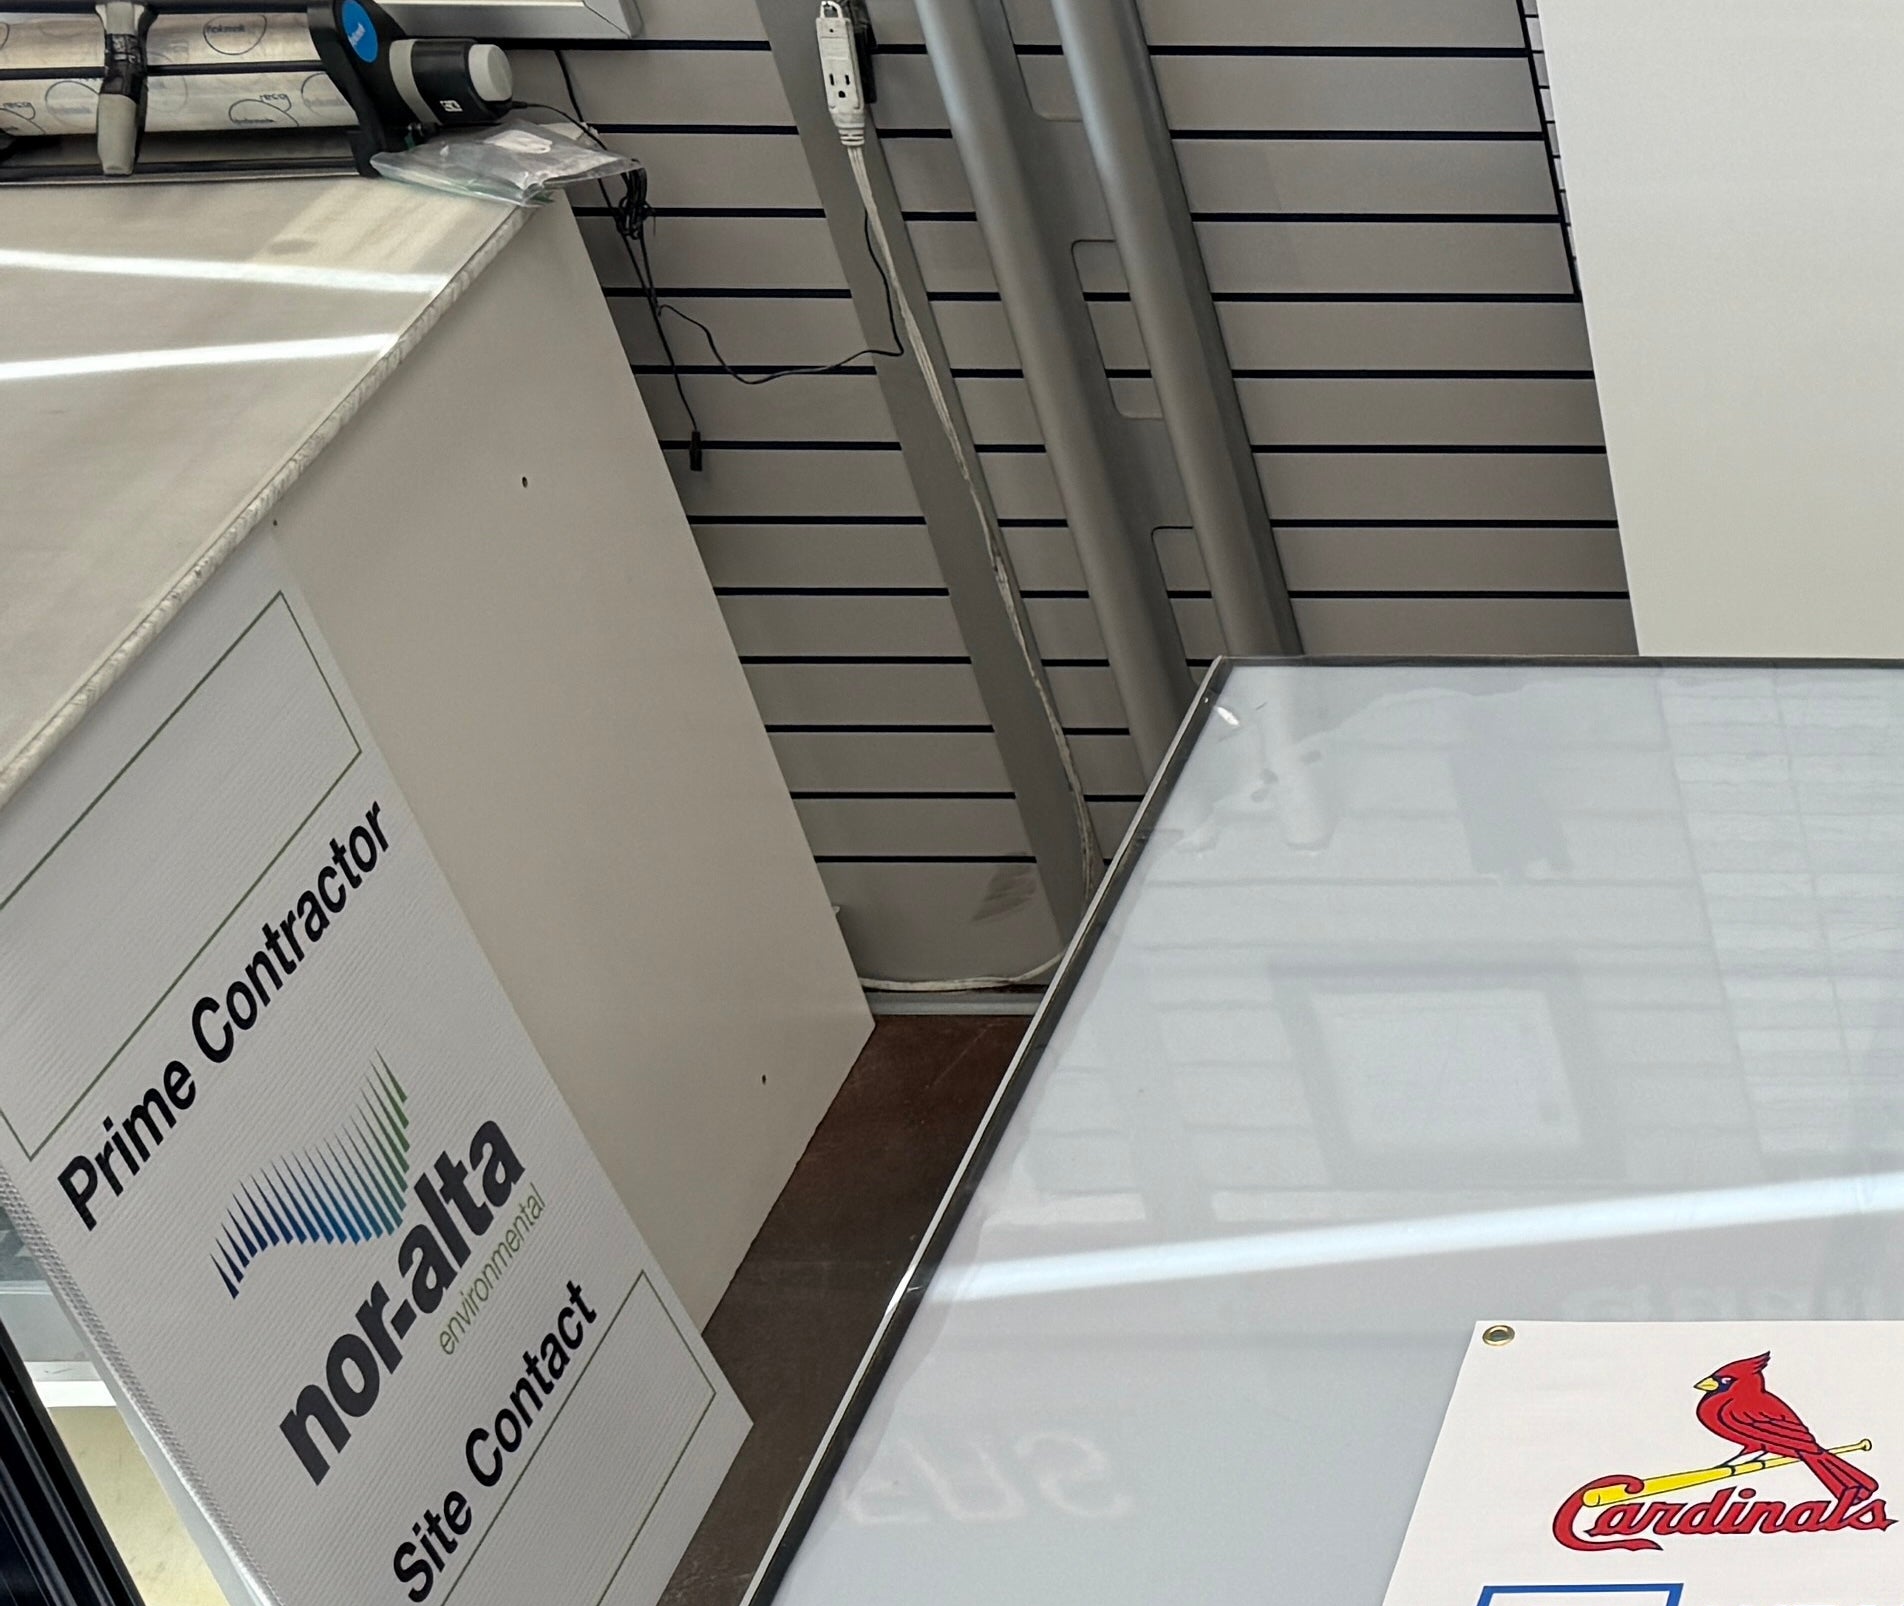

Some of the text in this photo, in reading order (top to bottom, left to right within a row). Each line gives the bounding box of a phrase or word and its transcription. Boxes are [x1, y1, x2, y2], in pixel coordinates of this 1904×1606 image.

[56, 801, 390, 1232] Prime Contractor
[278, 1119, 527, 1486] nor-alta
[438, 1181, 547, 1357] environmental
[391, 1278, 598, 1604] Site Contact
[1552, 1474, 1898, 1552] Cardinals
